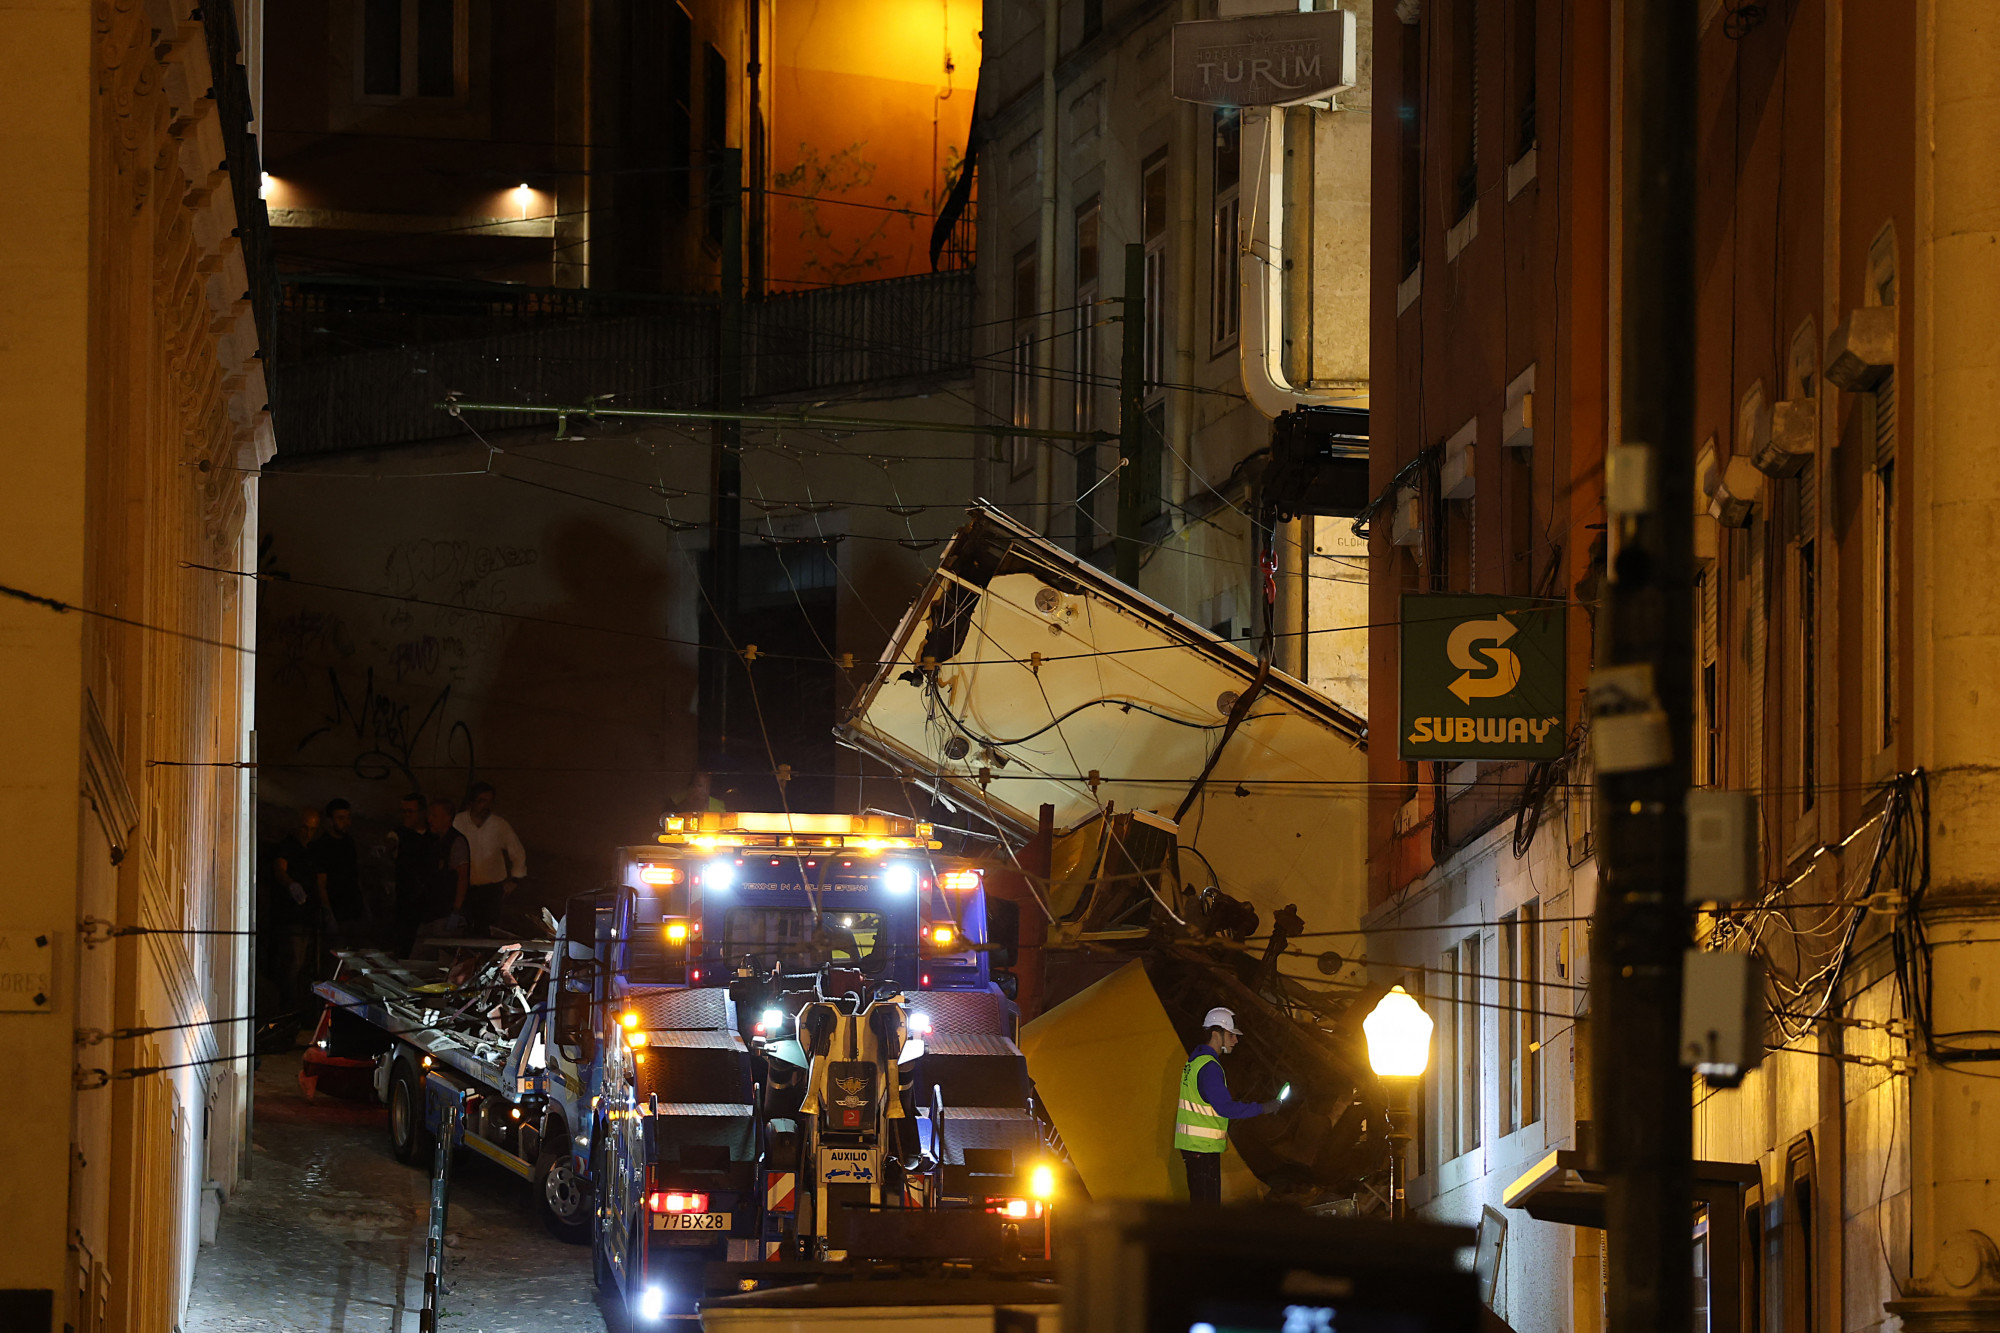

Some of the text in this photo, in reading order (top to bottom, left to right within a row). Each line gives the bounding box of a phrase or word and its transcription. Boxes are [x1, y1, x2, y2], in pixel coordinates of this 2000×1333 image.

[1197, 54, 1321, 89] TURIM
[1408, 716, 1560, 744] SUBWAY
[805, 883, 832, 892] BLE
[831, 1152, 868, 1161] AUXILIO
